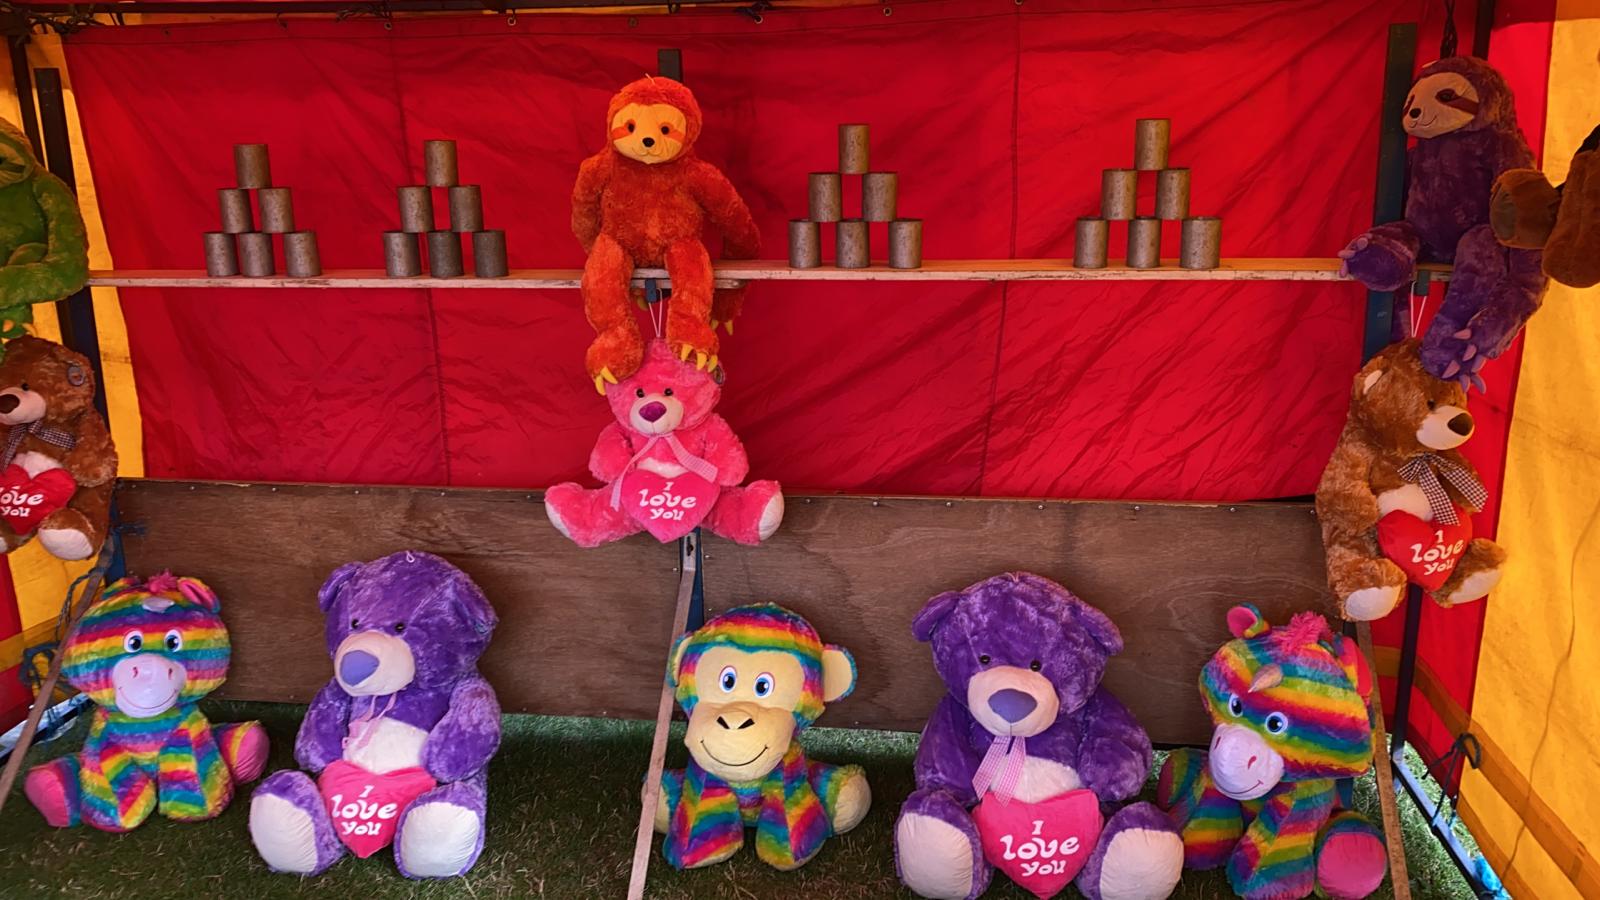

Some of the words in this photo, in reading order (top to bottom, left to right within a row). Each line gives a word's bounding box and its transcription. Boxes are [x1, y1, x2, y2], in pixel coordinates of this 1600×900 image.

[664, 481, 675, 491] I
[0, 486, 44, 505] ove
[639, 488, 697, 509] love
[649, 507, 685, 521] you
[1410, 539, 1464, 563] love
[1423, 558, 1455, 576] you
[358, 784, 375, 798] I
[331, 794, 398, 820] love
[341, 821, 382, 836] you
[1031, 820, 1044, 836] I
[1000, 834, 1079, 861] love
[1020, 860, 1066, 877] you
